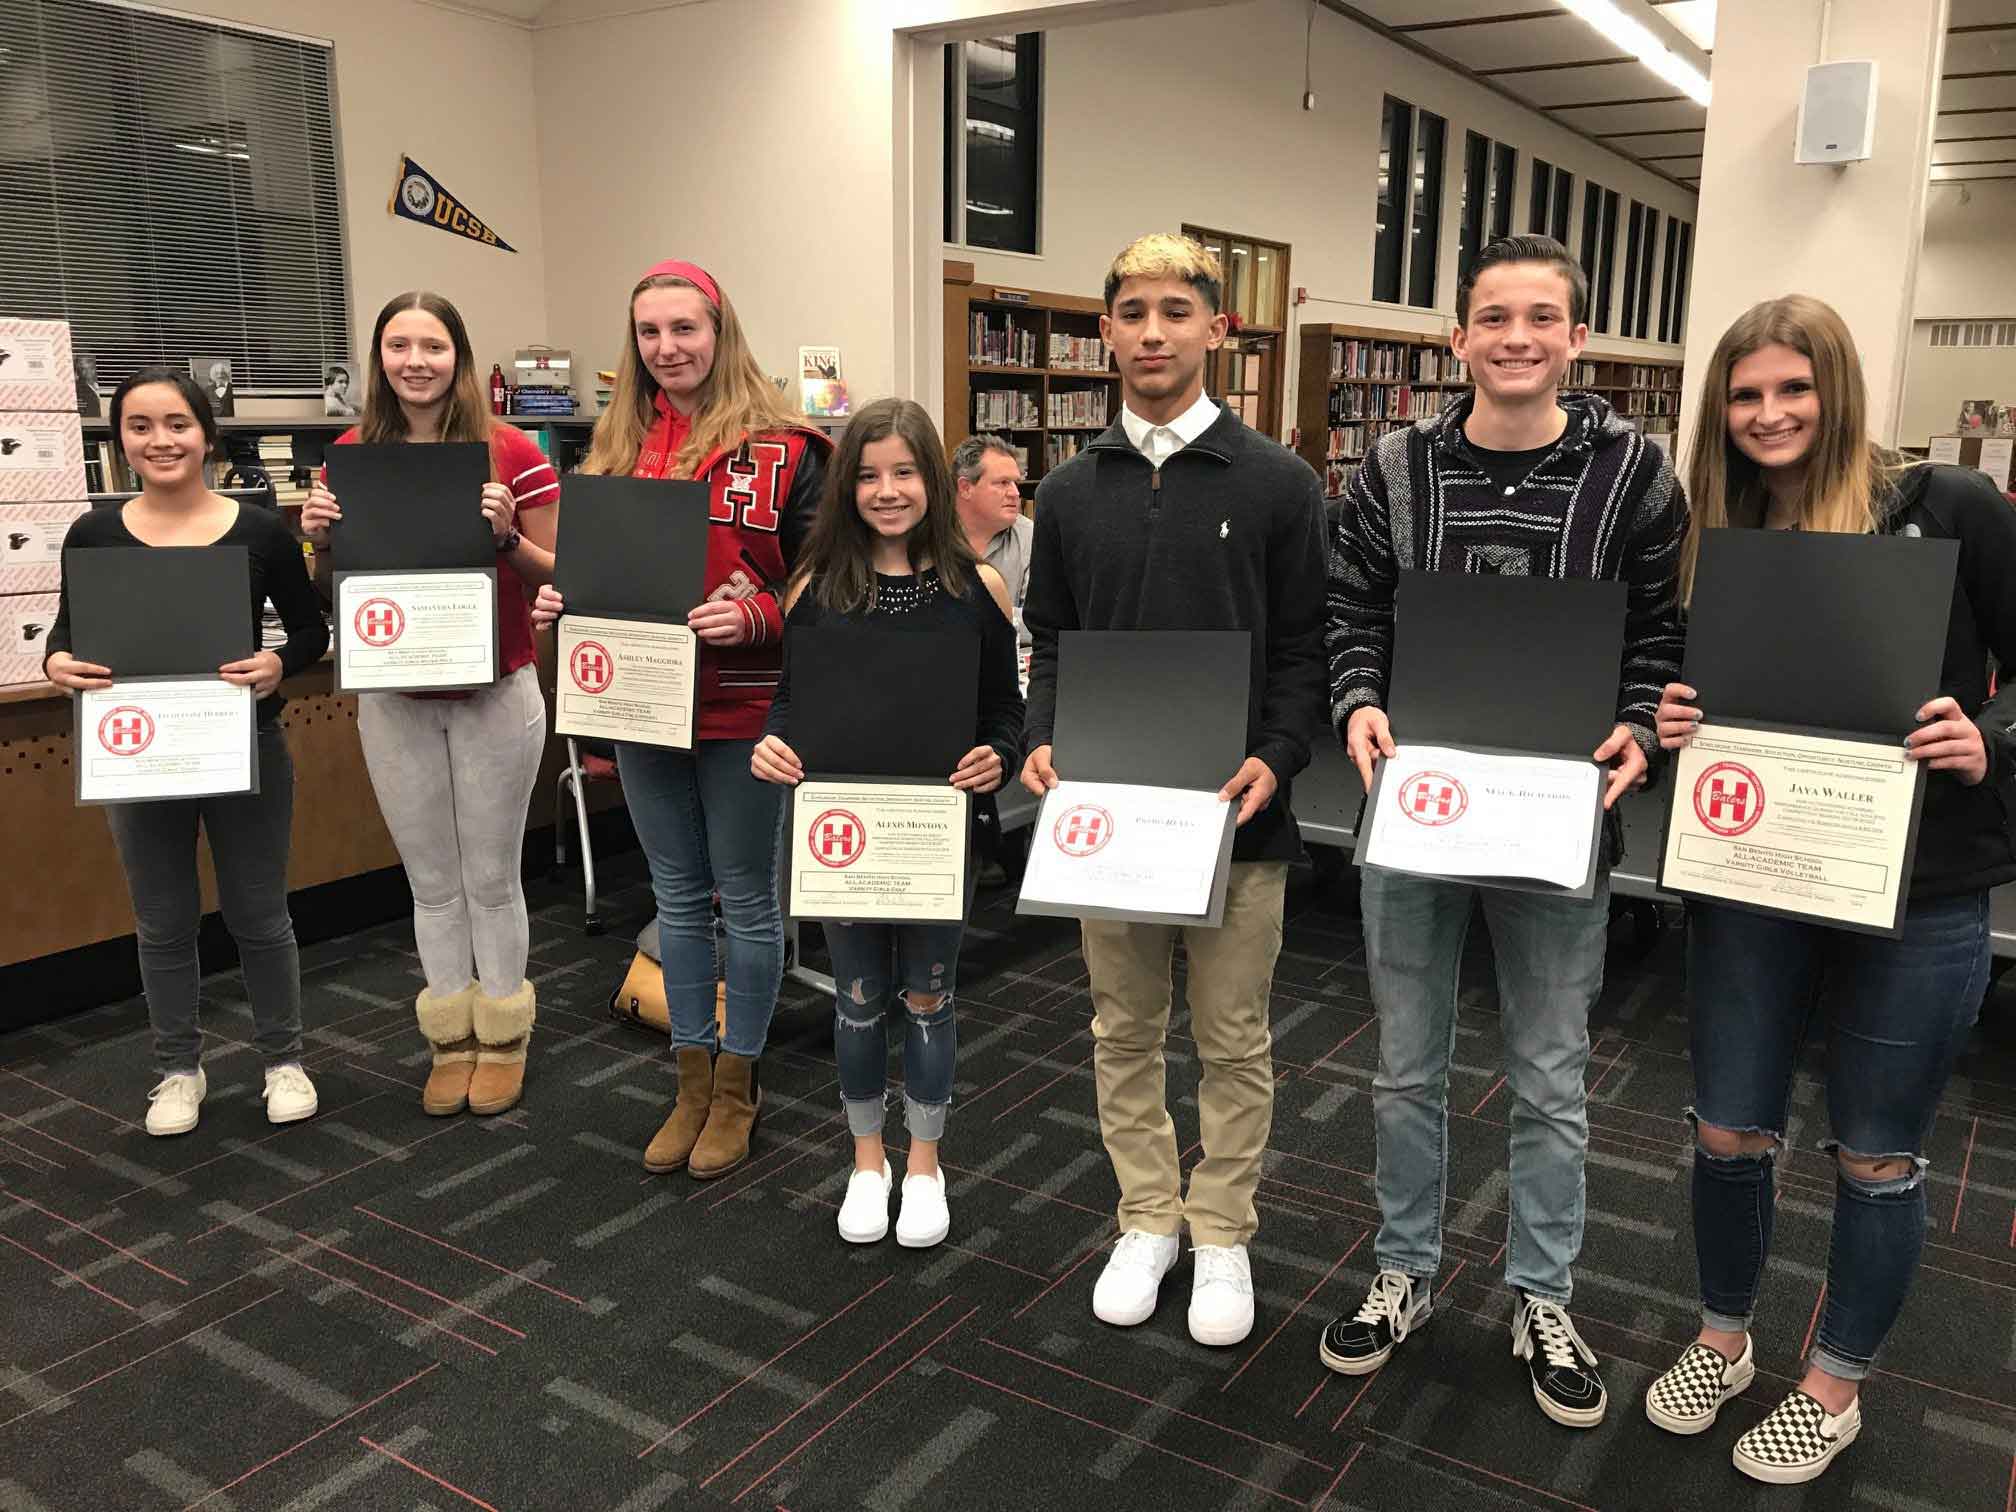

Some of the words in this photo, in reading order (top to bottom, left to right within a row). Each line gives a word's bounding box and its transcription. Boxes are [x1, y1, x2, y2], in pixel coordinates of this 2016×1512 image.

[434, 191, 498, 245] UCSB
[708, 441, 787, 536] H
[1789, 783, 1818, 796] JAYA
[1823, 787, 1873, 803] WALLER
[876, 821, 904, 829] ALEXIS
[1797, 862, 1822, 873] TEAM
